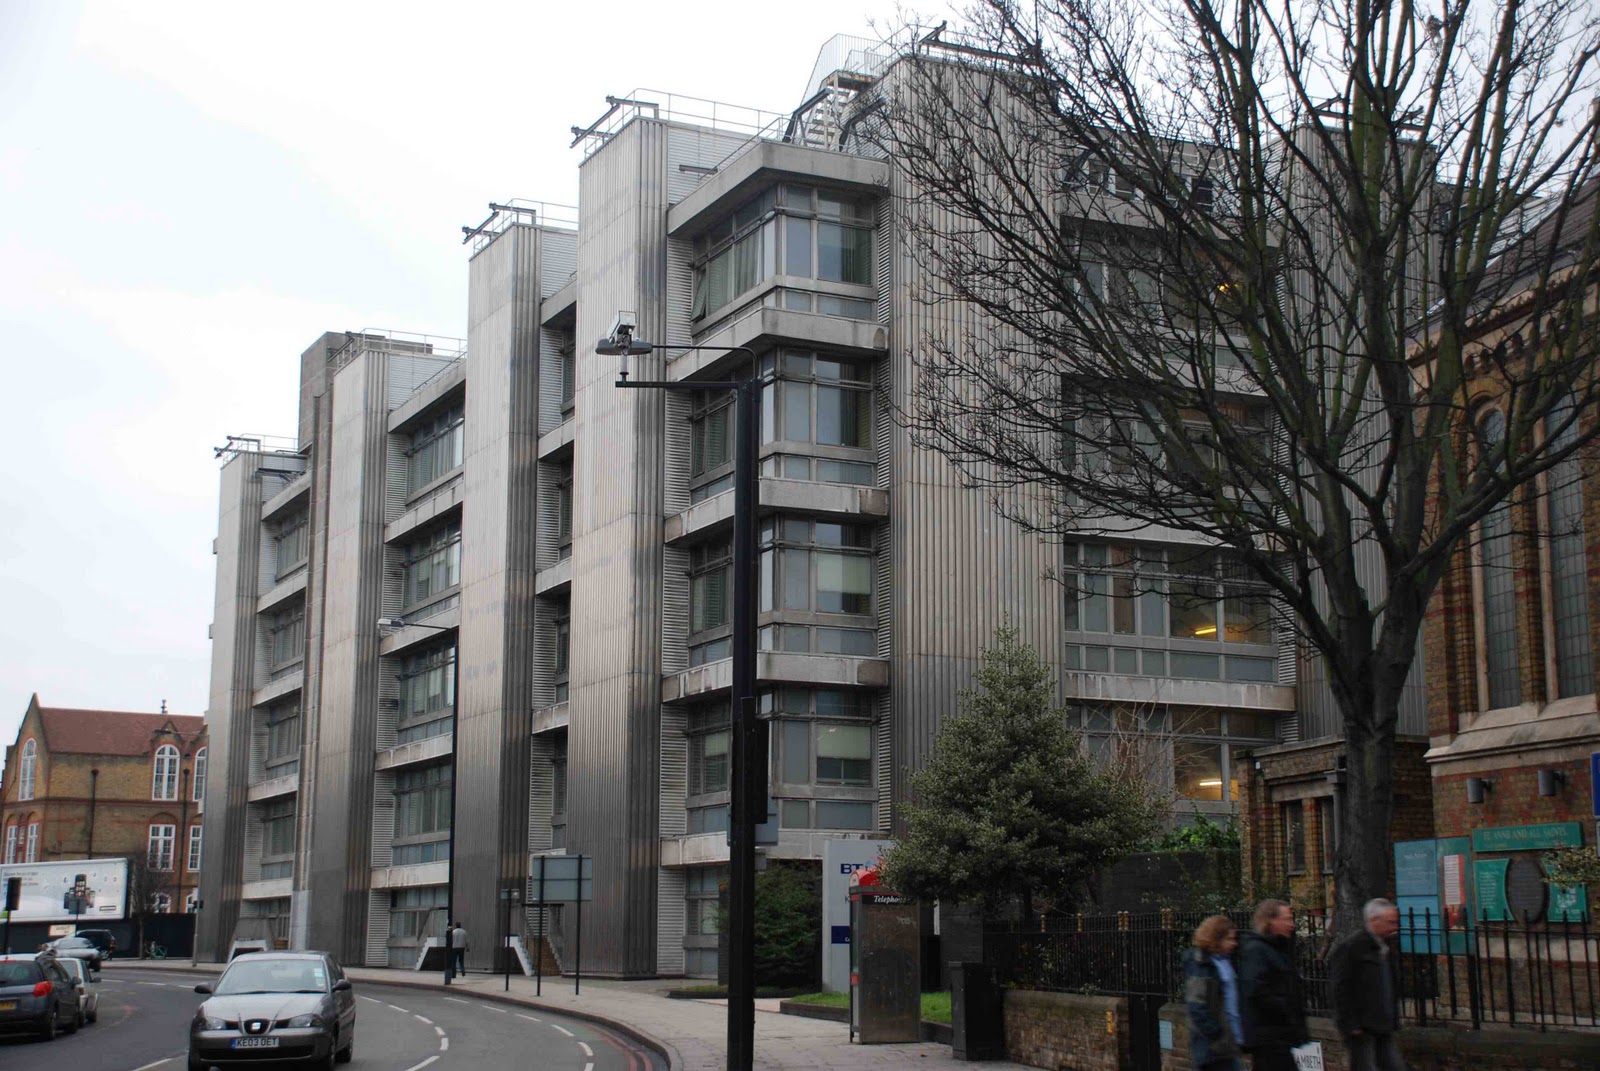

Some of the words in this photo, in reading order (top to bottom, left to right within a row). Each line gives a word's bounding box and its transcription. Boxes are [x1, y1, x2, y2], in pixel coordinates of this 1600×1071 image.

[840, 863, 863, 875] BT
[873, 895, 906, 905] Telepho
[237, 1038, 259, 1047] KE03
[1296, 1054, 1321, 1068] AMBETH
